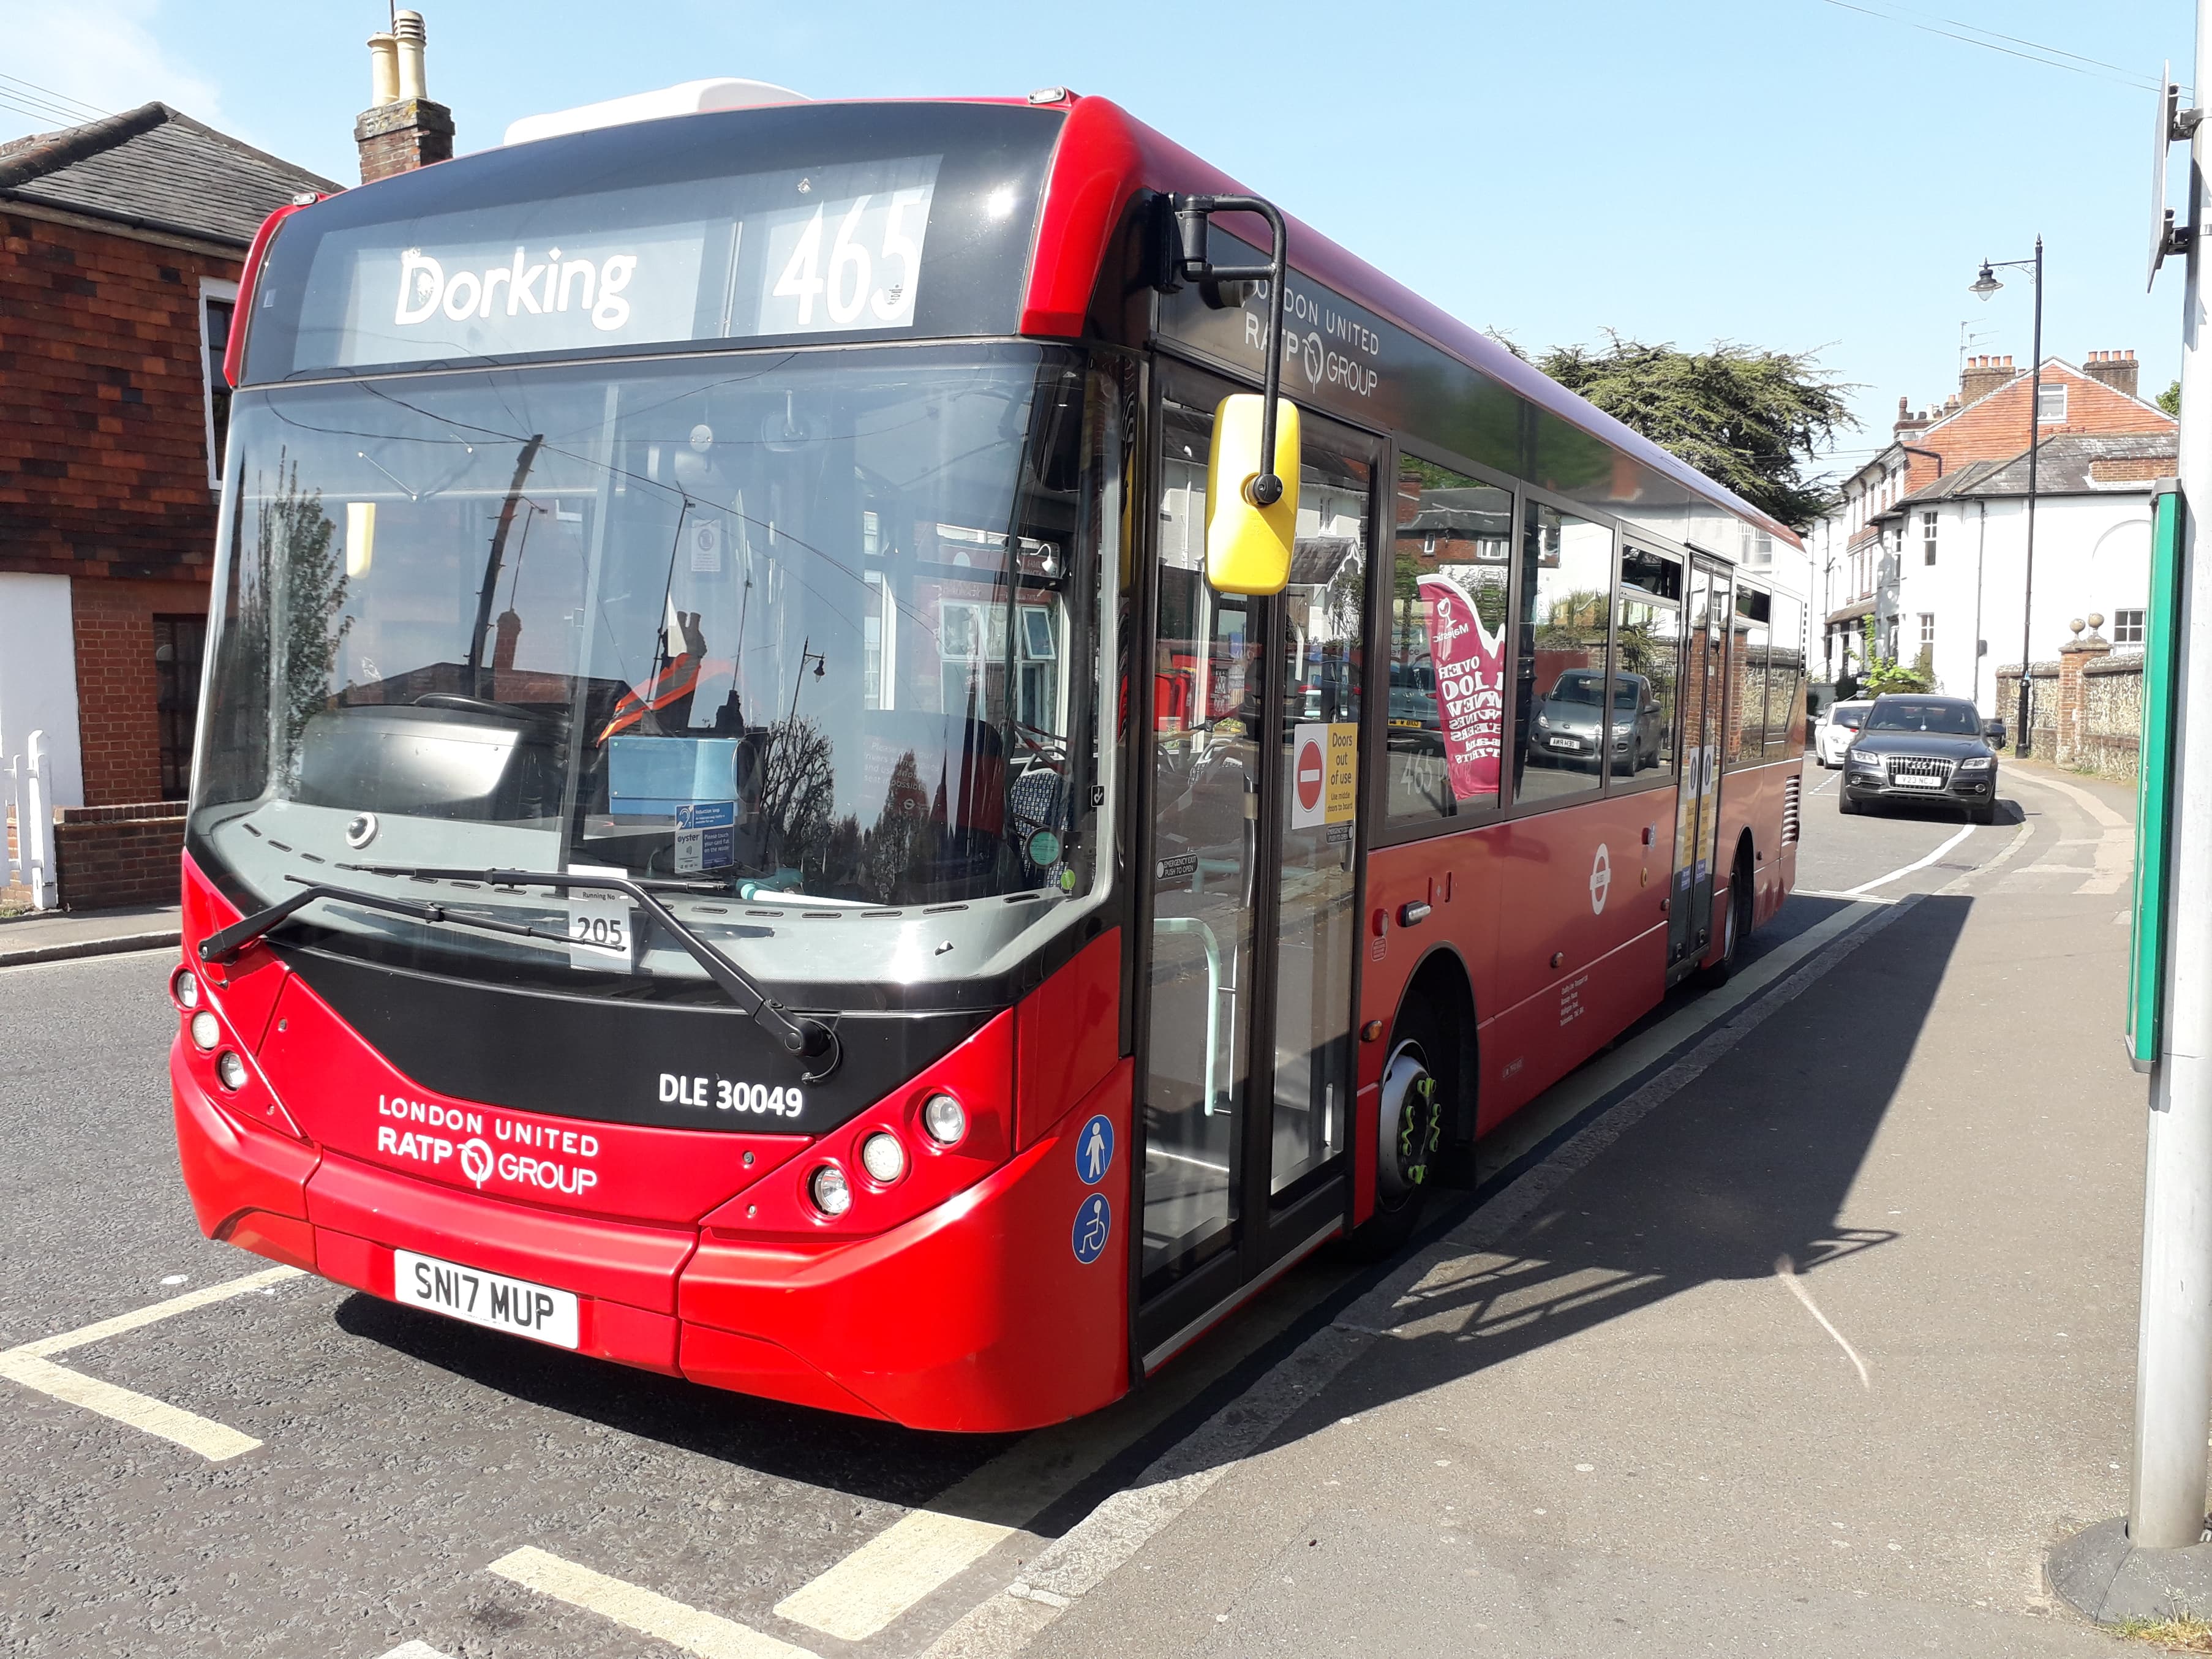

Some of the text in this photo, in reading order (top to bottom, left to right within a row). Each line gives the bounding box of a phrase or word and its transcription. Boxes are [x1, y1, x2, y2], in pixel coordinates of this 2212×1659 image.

[772, 192, 924, 325] 465
[394, 247, 638, 331] Dorking
[1245, 311, 1377, 397] RP GROUP
[1326, 309, 1379, 355] UNITED
[1332, 732, 1352, 748] Doors
[1336, 752, 1348, 766] out
[1331, 772, 1352, 785] of use
[1401, 748, 1434, 796] 465
[677, 833, 701, 844] oyster
[582, 892, 606, 900] Running
[577, 917, 623, 944] 205
[659, 1073, 803, 1118] DLE 30049
[378, 1094, 598, 1158] LONDON UNITED
[377, 1126, 598, 1195] RATP GROUP
[415, 1261, 554, 1331] SN17 MUP
